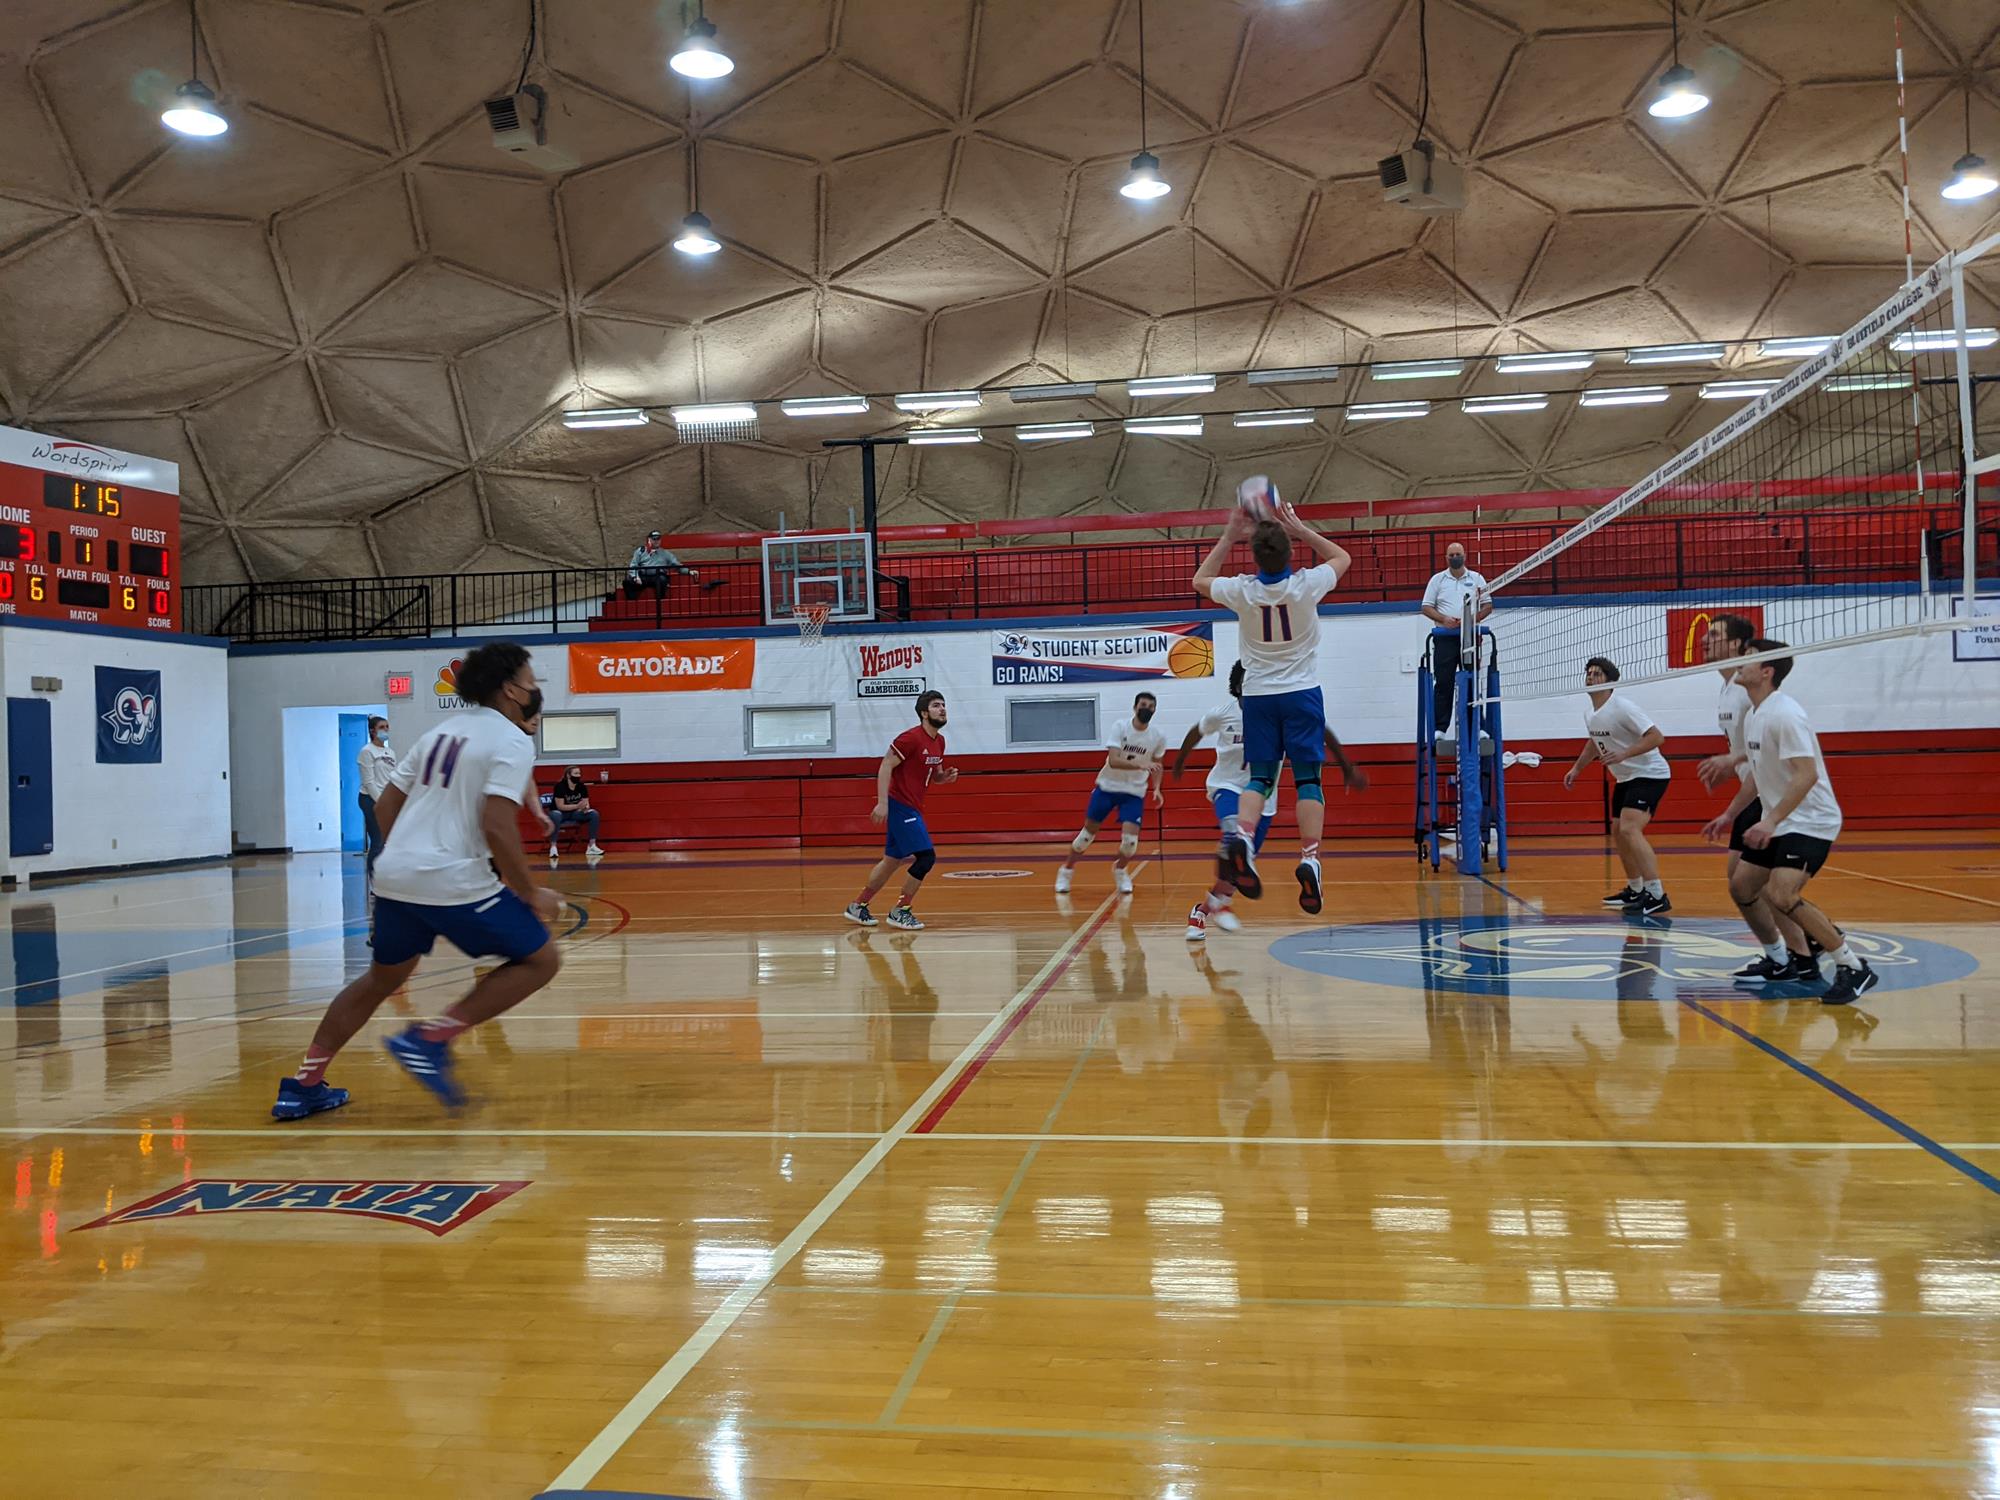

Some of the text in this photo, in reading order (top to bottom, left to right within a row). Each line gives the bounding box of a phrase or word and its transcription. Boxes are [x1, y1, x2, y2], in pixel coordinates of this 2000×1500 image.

[32, 443, 128, 473] Wordsprint
[73, 482, 120, 517] 1:15
[69, 524, 99, 538] PERIOD
[131, 527, 167, 545] GUEST
[19, 526, 36, 561] 3
[85, 542, 91, 563] 1
[161, 550, 168, 576] 1
[56, 567, 111, 584] PLAYER FOUL
[147, 578, 171, 591] FOULS
[30, 576, 44, 601] 6
[123, 587, 136, 611] 6
[155, 591, 168, 615] 0
[69, 609, 98, 622] MATCH
[147, 617, 172, 629] SCORE
[1259, 604, 1292, 642] 11
[1032, 635, 1168, 658] STUDENT SECTION
[598, 656, 725, 677] GATORADE
[996, 665, 1064, 684] GO RAMS!
[389, 677, 411, 694] EXIT
[865, 685, 920, 694] HAMBURGERS
[108, 1183, 500, 1226] NAIA
